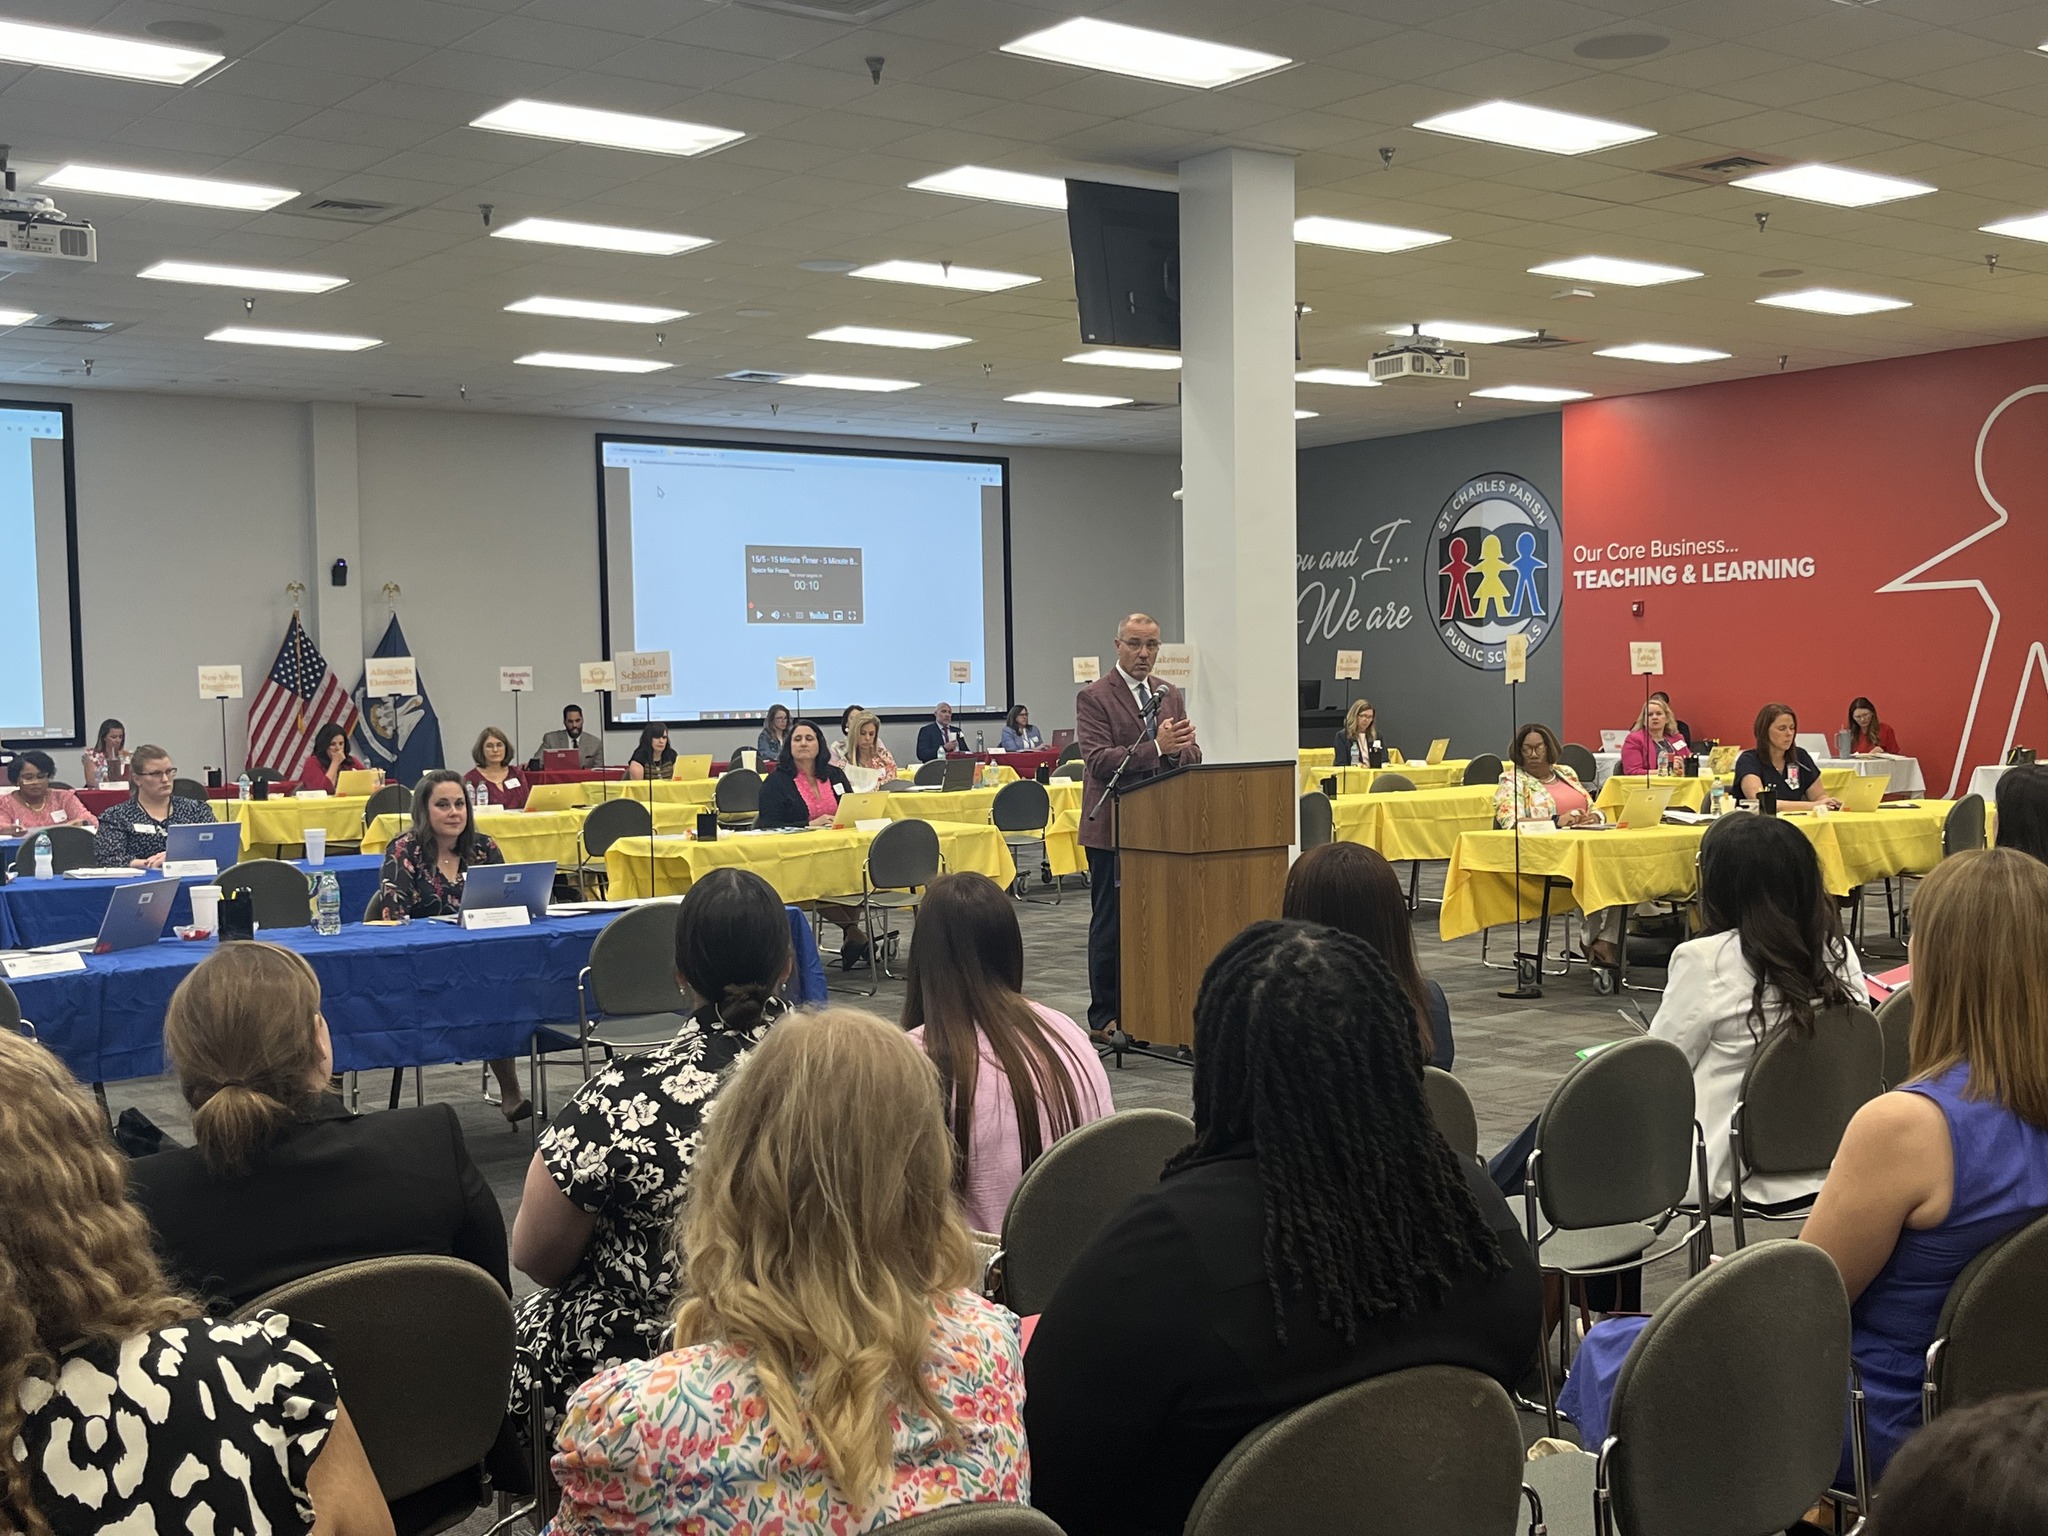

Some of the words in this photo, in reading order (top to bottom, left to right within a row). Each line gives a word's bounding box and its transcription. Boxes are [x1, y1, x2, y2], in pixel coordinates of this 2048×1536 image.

[1438, 512, 1454, 532] ST.
[1453, 479, 1506, 509] CHARLES
[1508, 483, 1548, 525] PARISH
[1297, 553, 1317, 571] ou
[1319, 537, 1362, 570] and
[1573, 545, 1603, 563] Our
[1607, 542, 1645, 560] Core
[1651, 538, 1739, 558] Business...
[751, 555, 766, 564] 15/5
[770, 556, 779, 564] 15
[779, 556, 801, 565] Minute
[801, 556, 819, 565] Timer
[823, 557, 828, 565] 5
[828, 557, 848, 565] Minute
[1573, 565, 1677, 590] TEACHING
[1681, 564, 1697, 584] &
[1702, 557, 1815, 583] LEARNING
[794, 580, 820, 591] 00:10
[1297, 576, 1362, 644] We
[1366, 601, 1413, 631] are
[1445, 627, 1484, 663] PUBLIC
[1487, 624, 1542, 664] SCLS
[632, 657, 656, 667] Ethel
[371, 667, 412, 676] Allemands
[621, 669, 669, 680] Schoeffner
[369, 679, 415, 687] Elementary
[620, 682, 671, 693] Elementary
